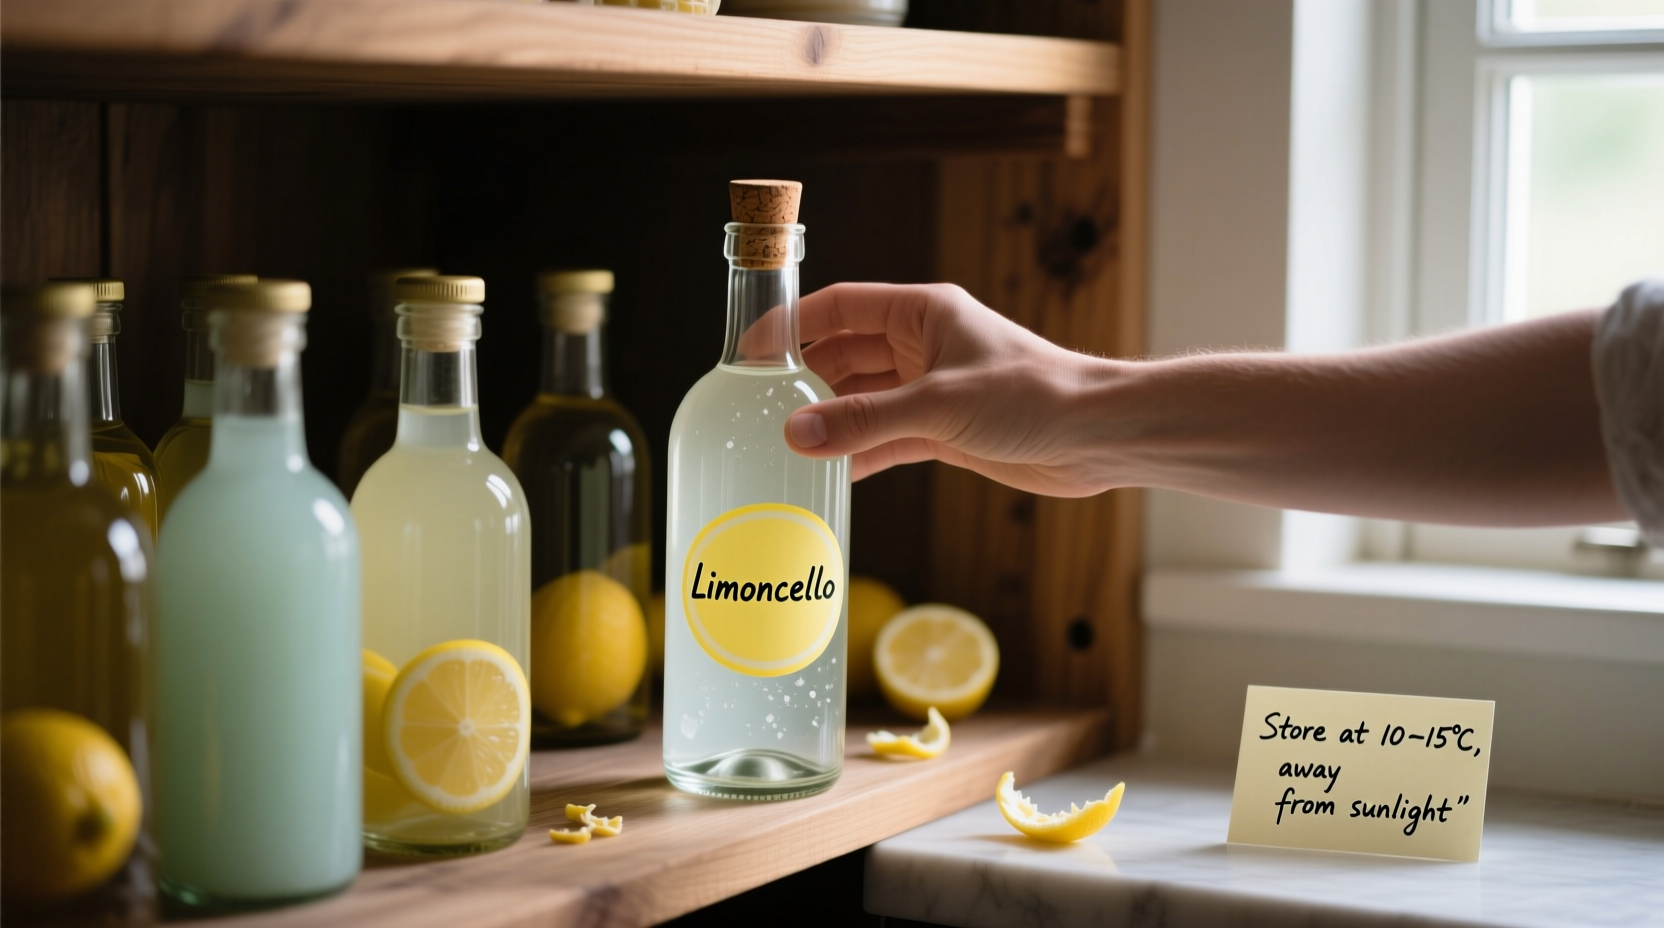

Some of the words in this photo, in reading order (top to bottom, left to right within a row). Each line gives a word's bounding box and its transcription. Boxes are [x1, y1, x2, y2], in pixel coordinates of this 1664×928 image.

[691, 562, 836, 602] Limoncello
[1259, 712, 1327, 742] Store
[1339, 721, 1370, 744] at
[1278, 762, 1342, 794] away
[1274, 787, 1336, 826] from
